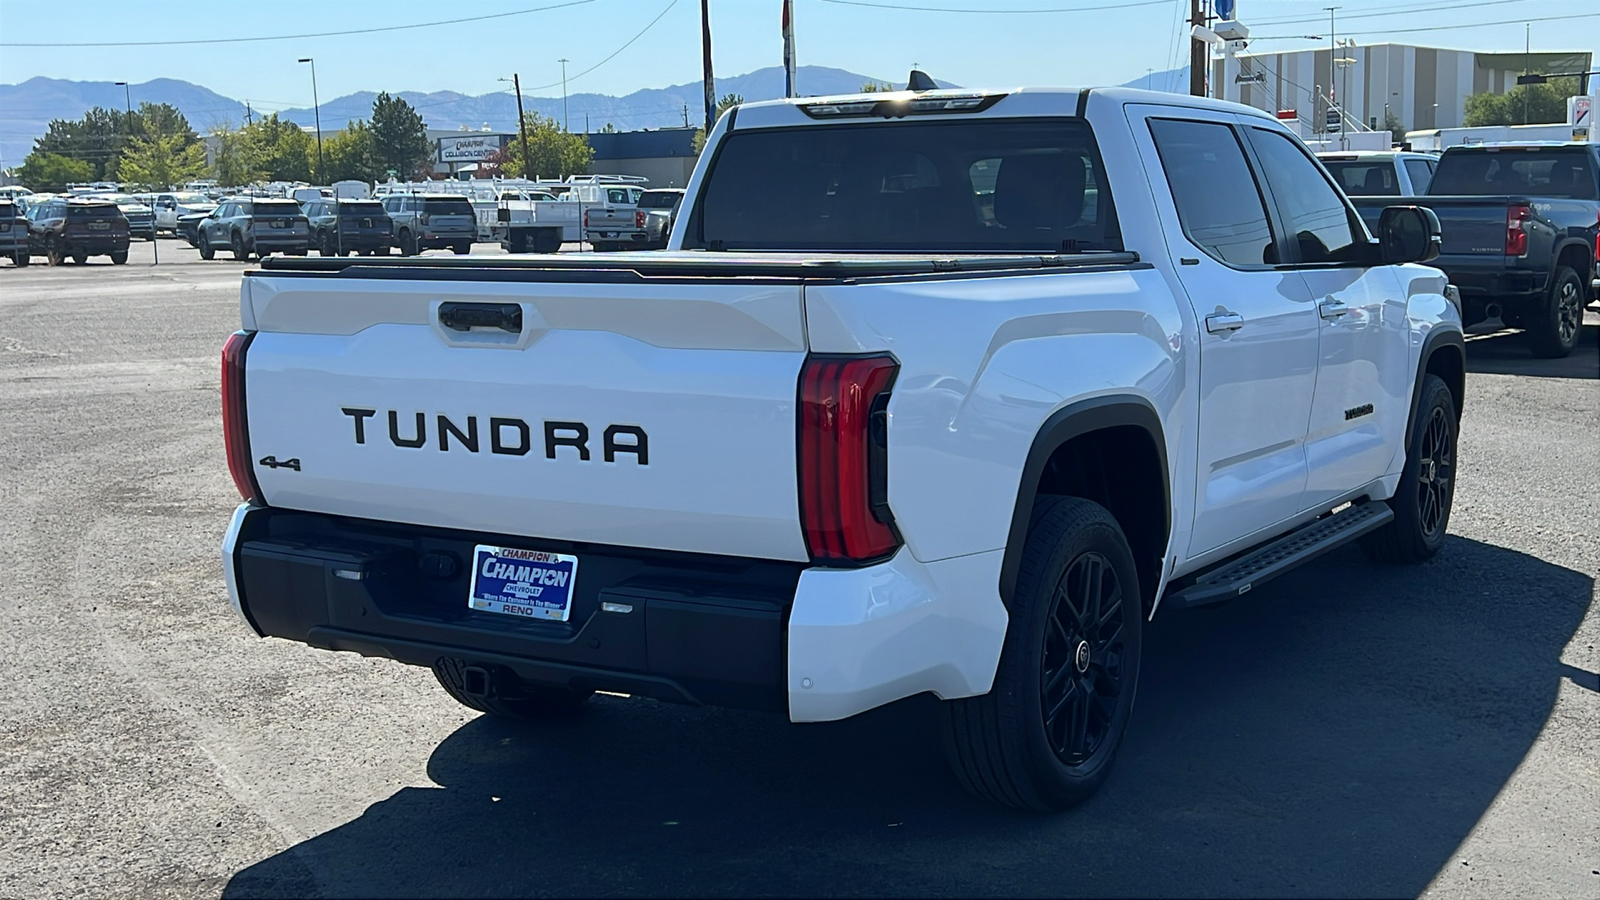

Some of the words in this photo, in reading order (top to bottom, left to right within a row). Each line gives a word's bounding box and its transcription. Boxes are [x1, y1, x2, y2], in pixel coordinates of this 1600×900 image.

[340, 407, 649, 466] TUNDRA
[501, 548, 551, 562] CHAMPION
[481, 558, 569, 588] CHAMPION
[505, 584, 541, 595] CHEVROLET
[502, 604, 534, 616] RENO
